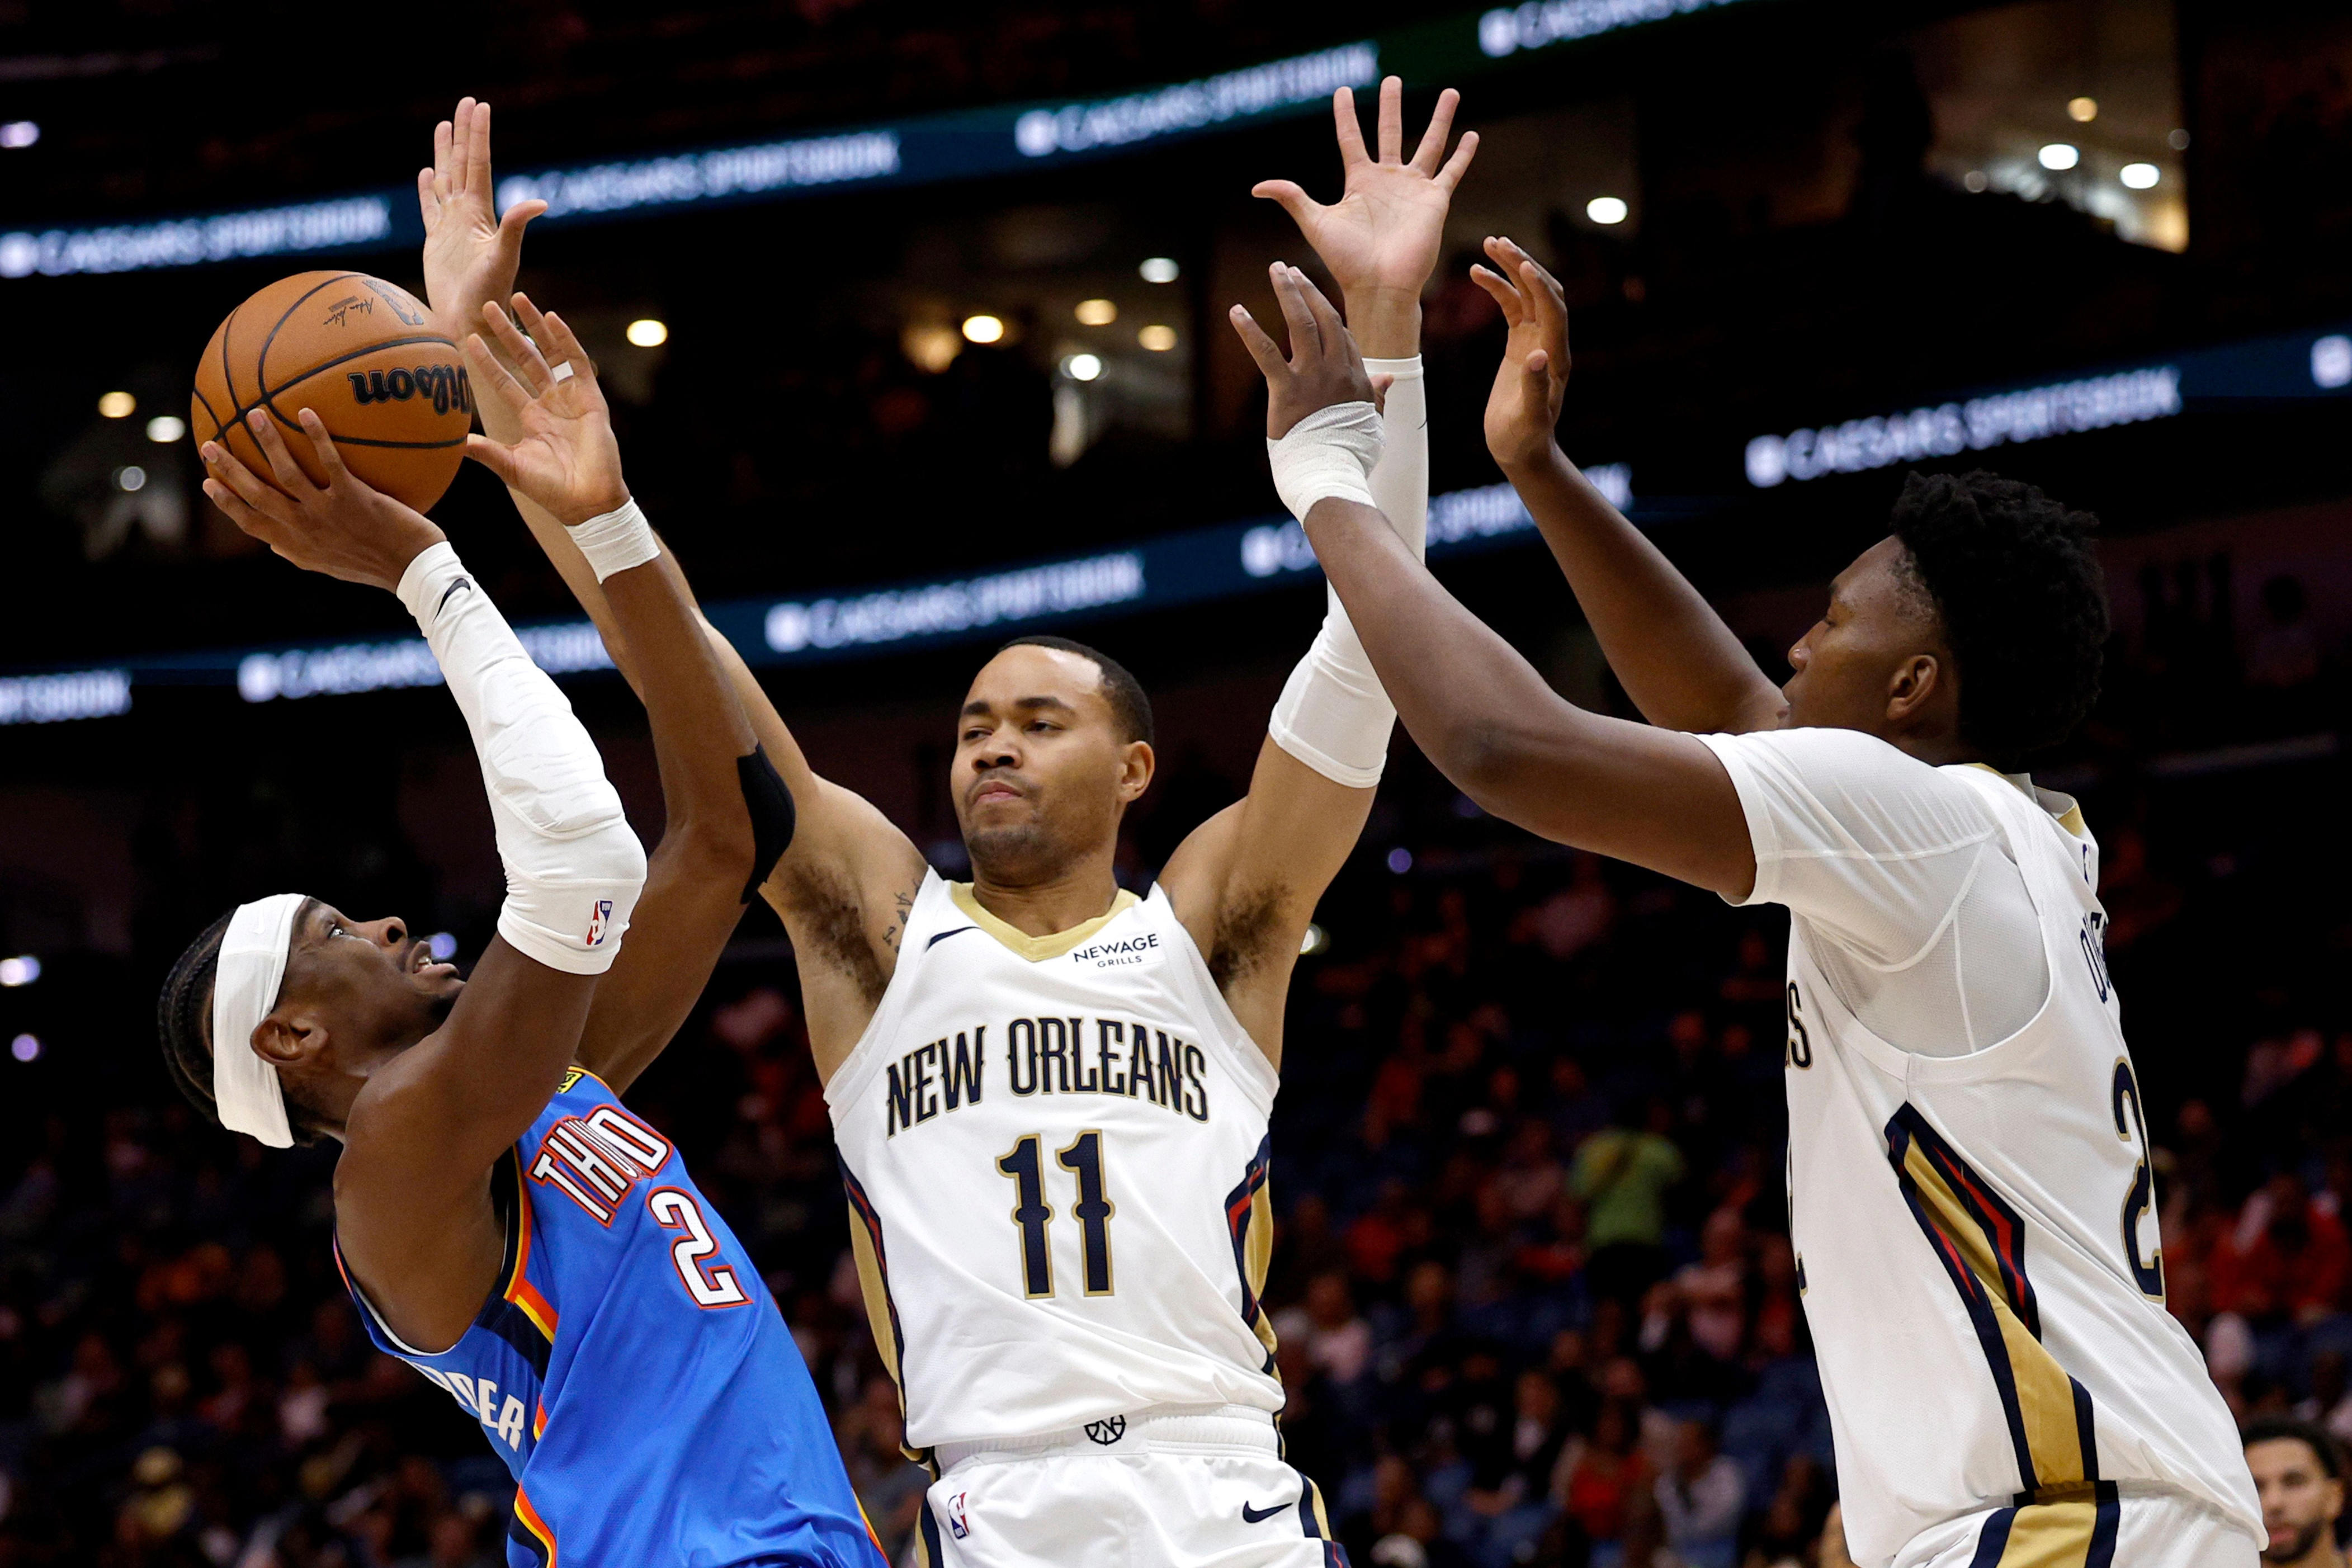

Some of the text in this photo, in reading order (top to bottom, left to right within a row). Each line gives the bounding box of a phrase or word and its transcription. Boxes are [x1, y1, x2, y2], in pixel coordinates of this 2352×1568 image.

[1073, 933, 1159, 962] NEWAGE
[1097, 955, 1142, 967] GRILLS
[886, 1016, 1209, 1141] NEW ORLEANS
[645, 1186, 754, 1310] 2
[994, 1128, 1116, 1300] 11
